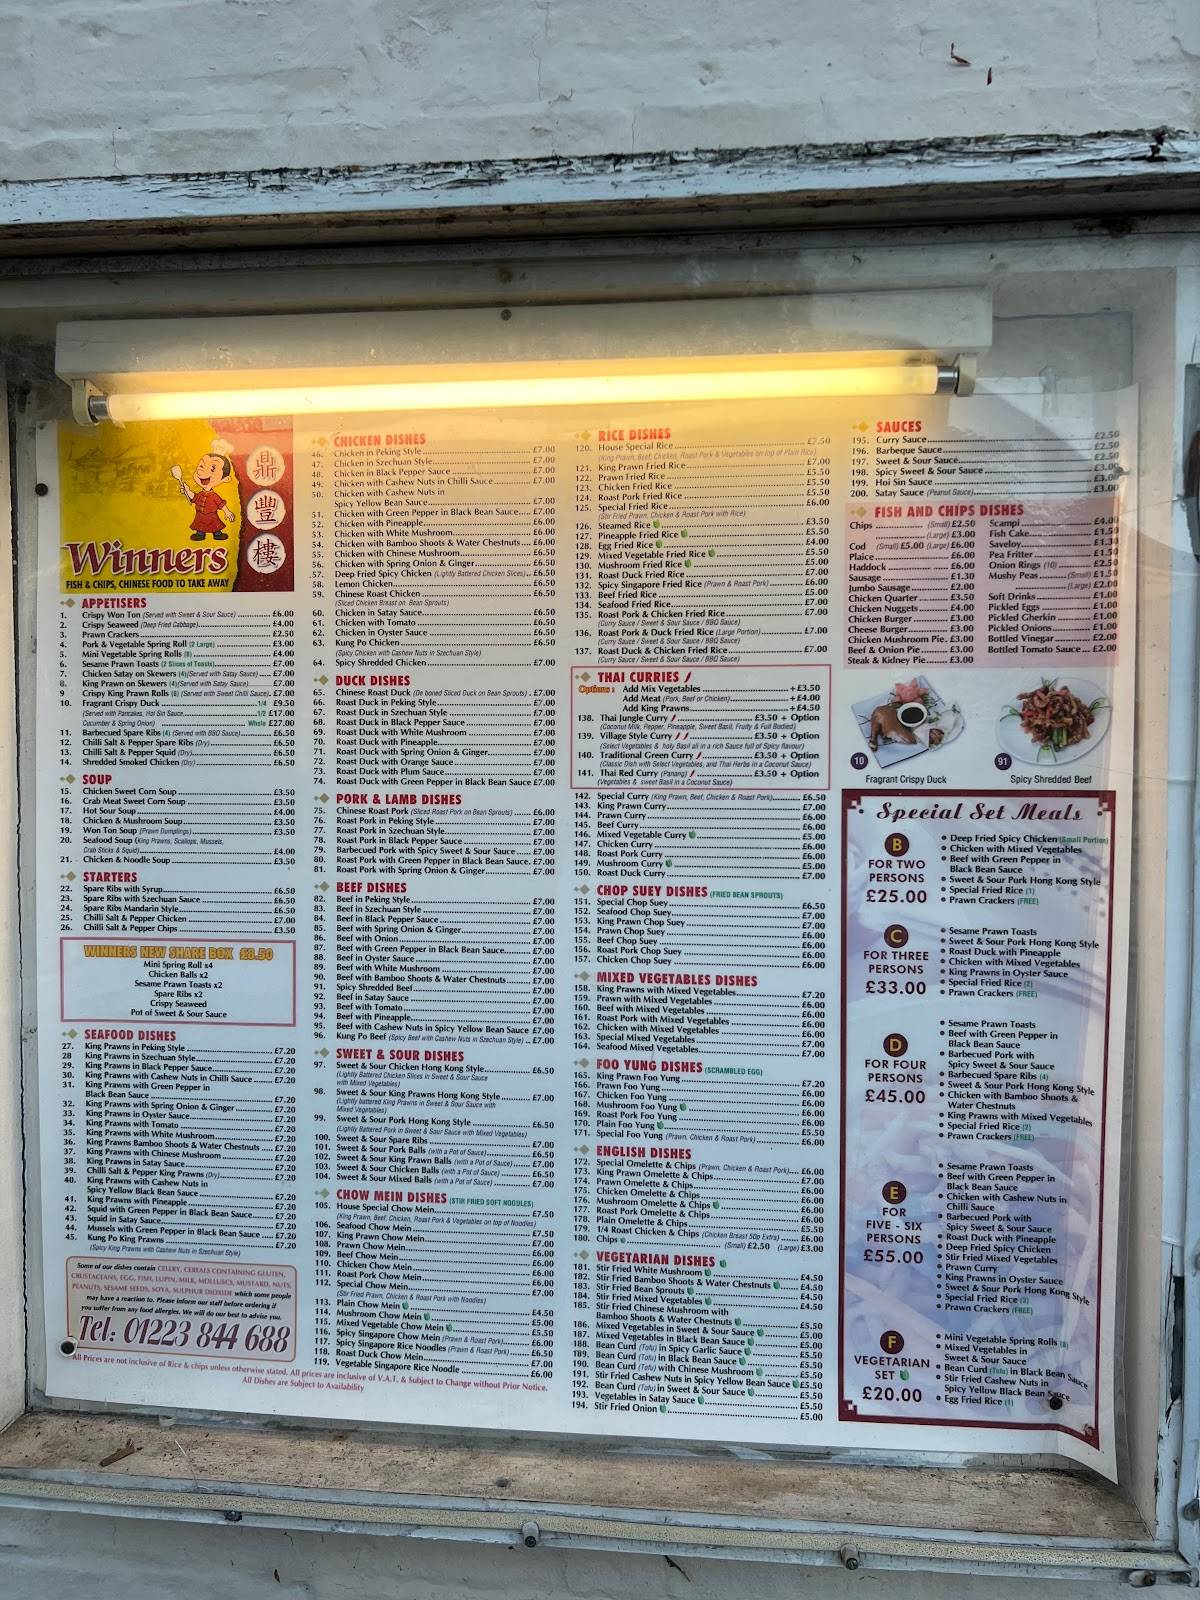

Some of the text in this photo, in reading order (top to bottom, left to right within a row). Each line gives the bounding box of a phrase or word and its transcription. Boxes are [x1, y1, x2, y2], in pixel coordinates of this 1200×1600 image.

[876, 421, 922, 432] SAUCES
[598, 428, 671, 441] RICE DISHES
[334, 434, 426, 447] CHICKEN DISHES
[875, 504, 1024, 518] FISH AND CHIPS DISHES
[65, 540, 228, 575] Winners
[66, 579, 229, 589] FISH & CHIPS, CHINESE FOOD TO TAKE AWAY
[82, 598, 147, 608] APPETISERS
[988, 602, 1019, 611] Pickled
[1021, 603, 1040, 612] Eggs
[336, 676, 410, 686] DUCK DISHES
[598, 672, 679, 682] THAI CURRIES
[998, 757, 1008, 766] 91
[83, 775, 112, 784] SOUP
[866, 775, 947, 785] Fragrant Crispy Duck
[1010, 775, 1092, 785] Spicy Shredded Beef
[159, 789, 177, 797] Soup
[336, 794, 462, 804] PORK & LAMB DISHES
[624, 812, 646, 821] Curry
[876, 802, 1083, 822] Special Set Meals
[893, 839, 902, 850] B
[869, 860, 926, 869] FOR TWO
[83, 872, 137, 882] STARTERS
[870, 873, 924, 883] PERSONS
[337, 882, 407, 893] BEEF DISHES
[597, 885, 628, 896] CHOP
[633, 886, 661, 896] SUEY
[666, 886, 708, 897] DISHES
[710, 890, 731, 899] (FRIED
[751, 891, 783, 900] SPROUTS)
[866, 890, 927, 903] £25.00
[891, 930, 902, 942] C
[84, 946, 273, 960] WINNERS NEW SHARE BOX £8.50
[864, 951, 929, 960] FOR THREE
[365, 955, 390, 963] Oyster
[162, 961, 185, 970] Spring
[869, 964, 924, 974] PERSONS
[597, 973, 758, 986] MIXED VEGETABLES DISHES
[866, 981, 926, 994] £33.00
[978, 989, 1014, 998] Crackers
[1016, 990, 1037, 998] (FREE)
[981, 1020, 1008, 1028] Prawn
[85, 1030, 176, 1041] SEAFOOD DISHES
[890, 1039, 901, 1050] D
[336, 1049, 464, 1061] SWEET & SOUR DISHES
[597, 1060, 763, 1076] FOO YUNG DISHES (SCRAMBLED EGG)
[865, 1060, 926, 1069] FOR FOUR
[868, 1073, 923, 1083] PERSONS
[865, 1089, 925, 1103] £45.00
[388, 1136, 409, 1145] Spare
[412, 1136, 428, 1144] Ribs
[597, 1146, 691, 1159] ENGLISH DISHES
[337, 1190, 447, 1203] CHOW MEIN DISHES
[890, 1187, 898, 1199] E
[883, 1207, 906, 1217] FOR
[866, 1221, 922, 1231] FIVE SIX
[867, 1234, 921, 1244] PERSONS
[597, 1252, 715, 1266] VEGETARIAN DISHES
[864, 1250, 923, 1264] £55.00
[80, 1316, 290, 1352] Tel: 01223 844 688
[888, 1336, 897, 1348] F
[854, 1356, 930, 1368] VEGETARIAN
[875, 1371, 895, 1380] SET
[290, 1380, 315, 1389] Subject
[326, 1383, 364, 1392] Availability
[862, 1387, 922, 1402] £20.00
[945, 1395, 958, 1405] Egg
[961, 1395, 983, 1404] Fried
[985, 1397, 1002, 1405] Rice
